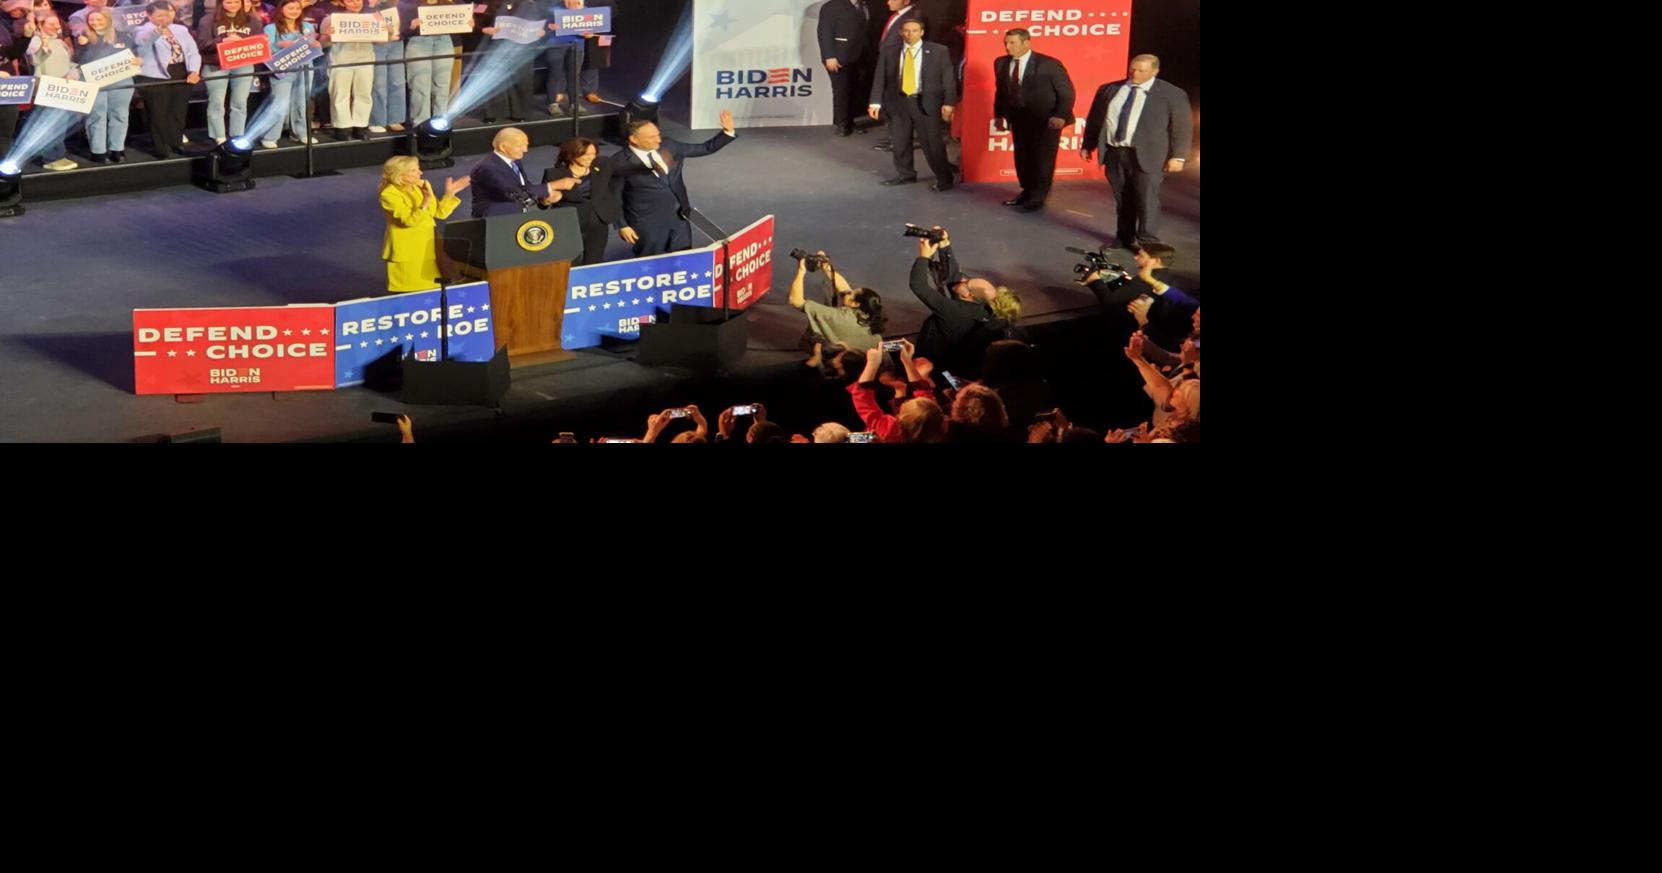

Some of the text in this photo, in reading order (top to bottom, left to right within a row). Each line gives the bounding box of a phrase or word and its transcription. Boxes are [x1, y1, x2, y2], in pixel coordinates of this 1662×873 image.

[562, 14, 604, 23] BIDEN
[981, 9, 1082, 22] DEFEND
[562, 21, 604, 29] HARRIS
[1028, 23, 1121, 36] CHOICE
[224, 43, 264, 56] DEFEND
[226, 50, 264, 62] CHOICE
[273, 44, 309, 67] DEFEND
[91, 59, 131, 76] DEFEND
[279, 51, 312, 71] CHOICE
[95, 66, 130, 81] CHOICE
[716, 68, 813, 85] BIDEN
[45, 91, 88, 104] HARRIS
[47, 84, 89, 98] BIDEN
[716, 85, 813, 99] HARRIS
[715, 242, 758, 279] DFEND
[735, 249, 771, 282] CHOICE
[571, 271, 688, 300] RESTORE
[662, 284, 711, 304] ROE
[138, 325, 278, 343] DEFEND
[206, 343, 327, 359] CHOICE
[210, 376, 261, 384] HARRIS
